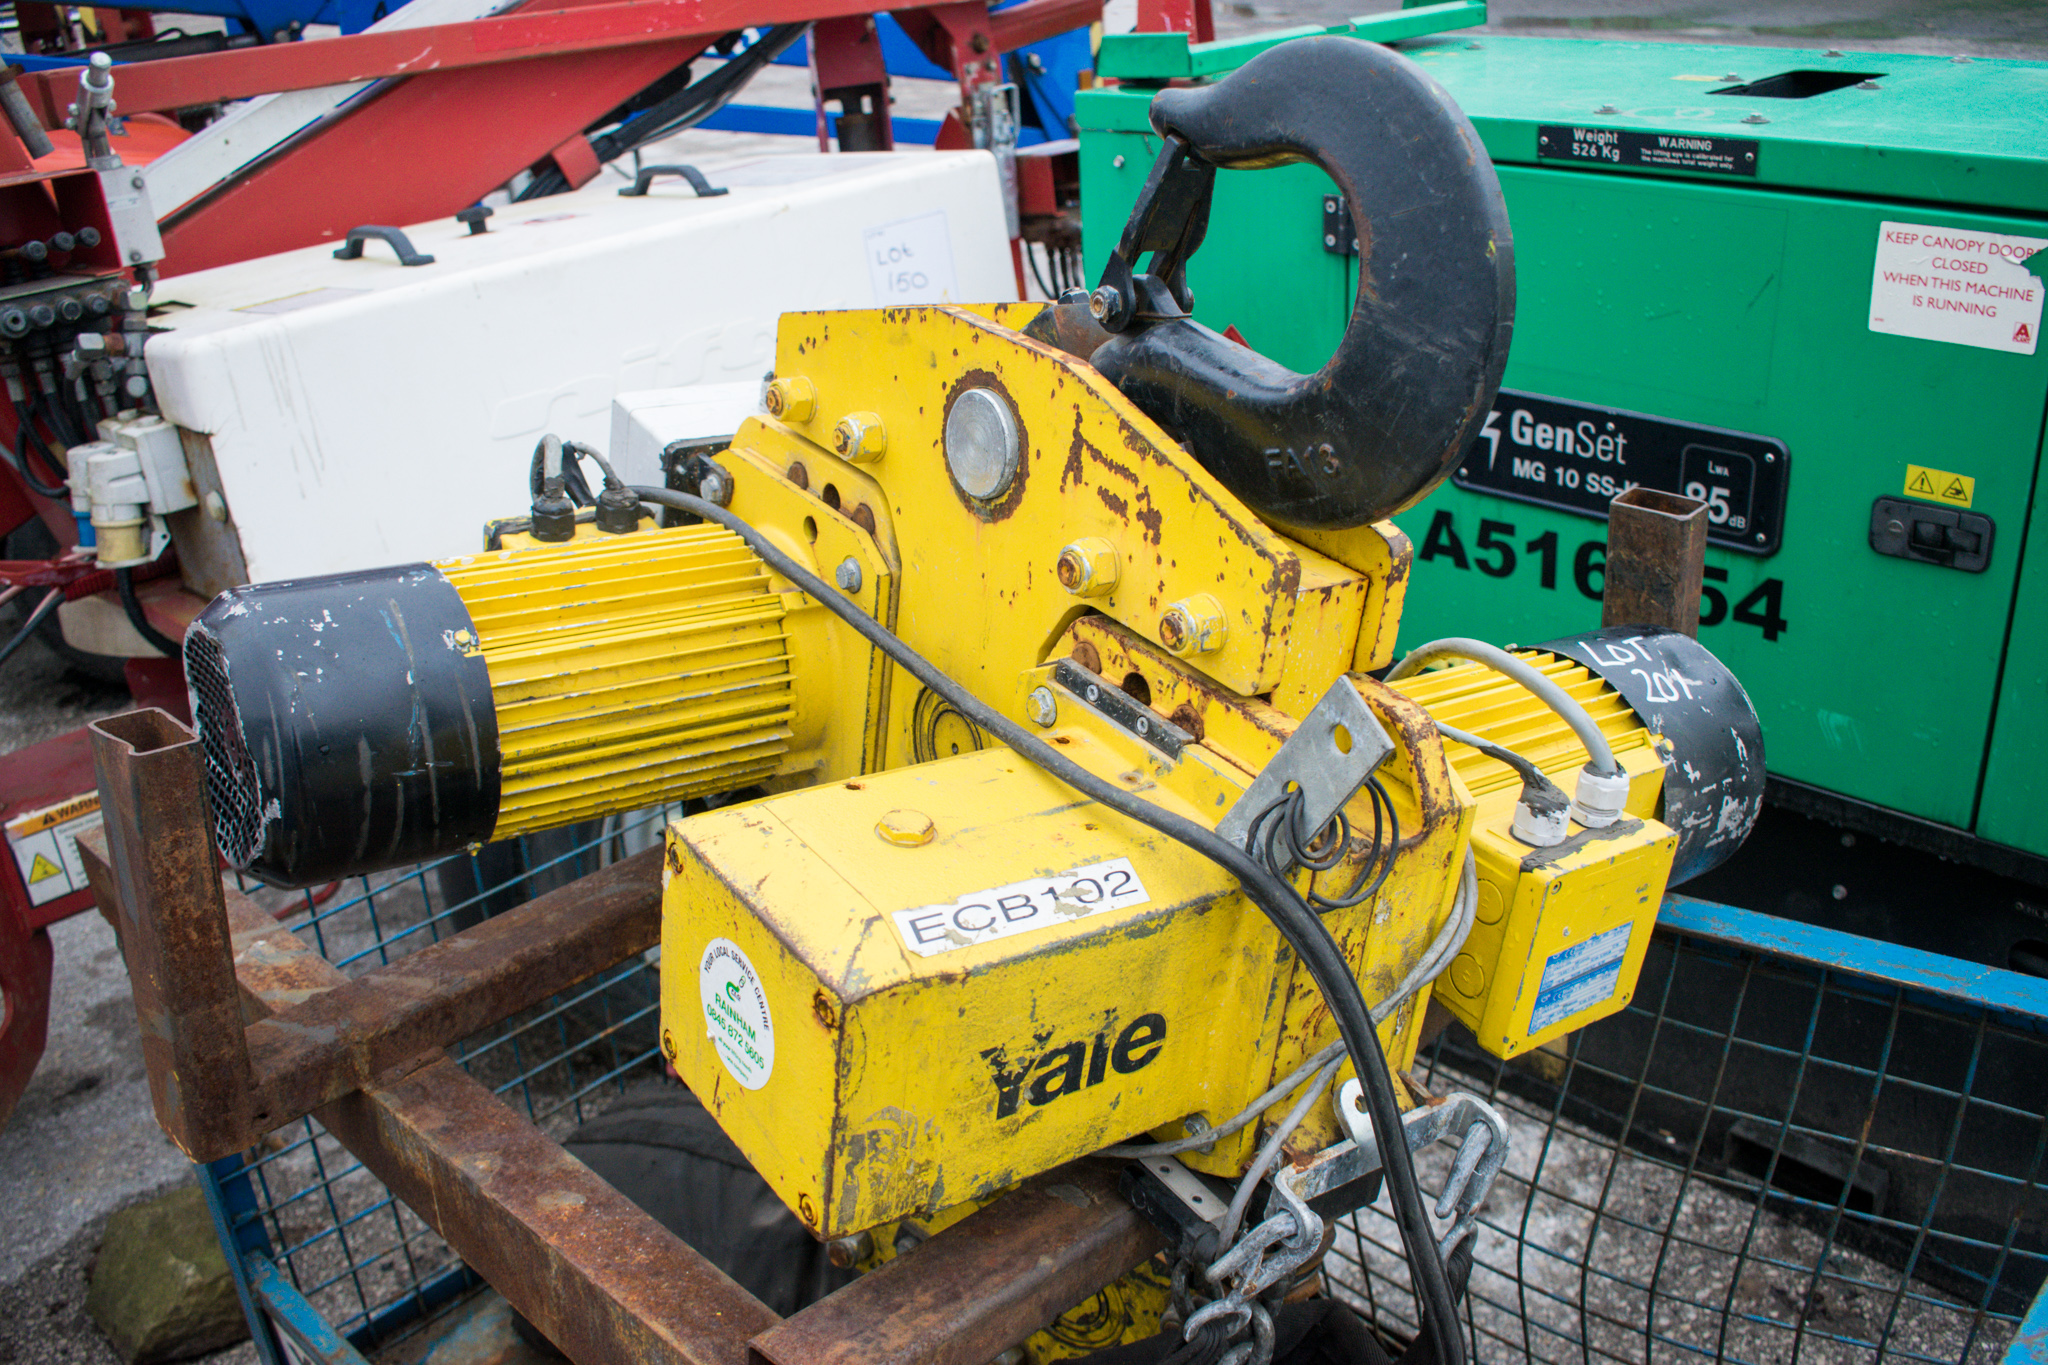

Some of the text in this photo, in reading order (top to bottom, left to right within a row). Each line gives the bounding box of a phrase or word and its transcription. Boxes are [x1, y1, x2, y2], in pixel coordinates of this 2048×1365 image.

[1572, 142, 1621, 162] 526 Kg
[1573, 128, 1618, 145] Weight
[1658, 136, 1713, 152] WARNING
[1885, 231, 2043, 260] KEEP CANOPY DOOR
[1931, 257, 1989, 275] CLOSED
[1883, 271, 2034, 302] WHEN THIS MACHINE
[1912, 295, 1997, 318] IS RUNNING
[1510, 408, 1628, 466] GenSet
[1513, 457, 1546, 483] MG
[1554, 467, 1580, 489] 10
[1728, 514, 1746, 529] dB
[1418, 509, 1788, 643] A51654
[1578, 635, 1653, 666] LOT
[908, 870, 1138, 945] ECB102
[713, 946, 730, 959] LOCAL
[731, 950, 755, 985] SERVICE
[754, 986, 770, 1031] CENTRE
[706, 1003, 726, 1030] 0845
[728, 1024, 744, 1048] 872
[715, 992, 756, 1043] RAINHAM
[979, 1007, 1167, 1120] Yale
